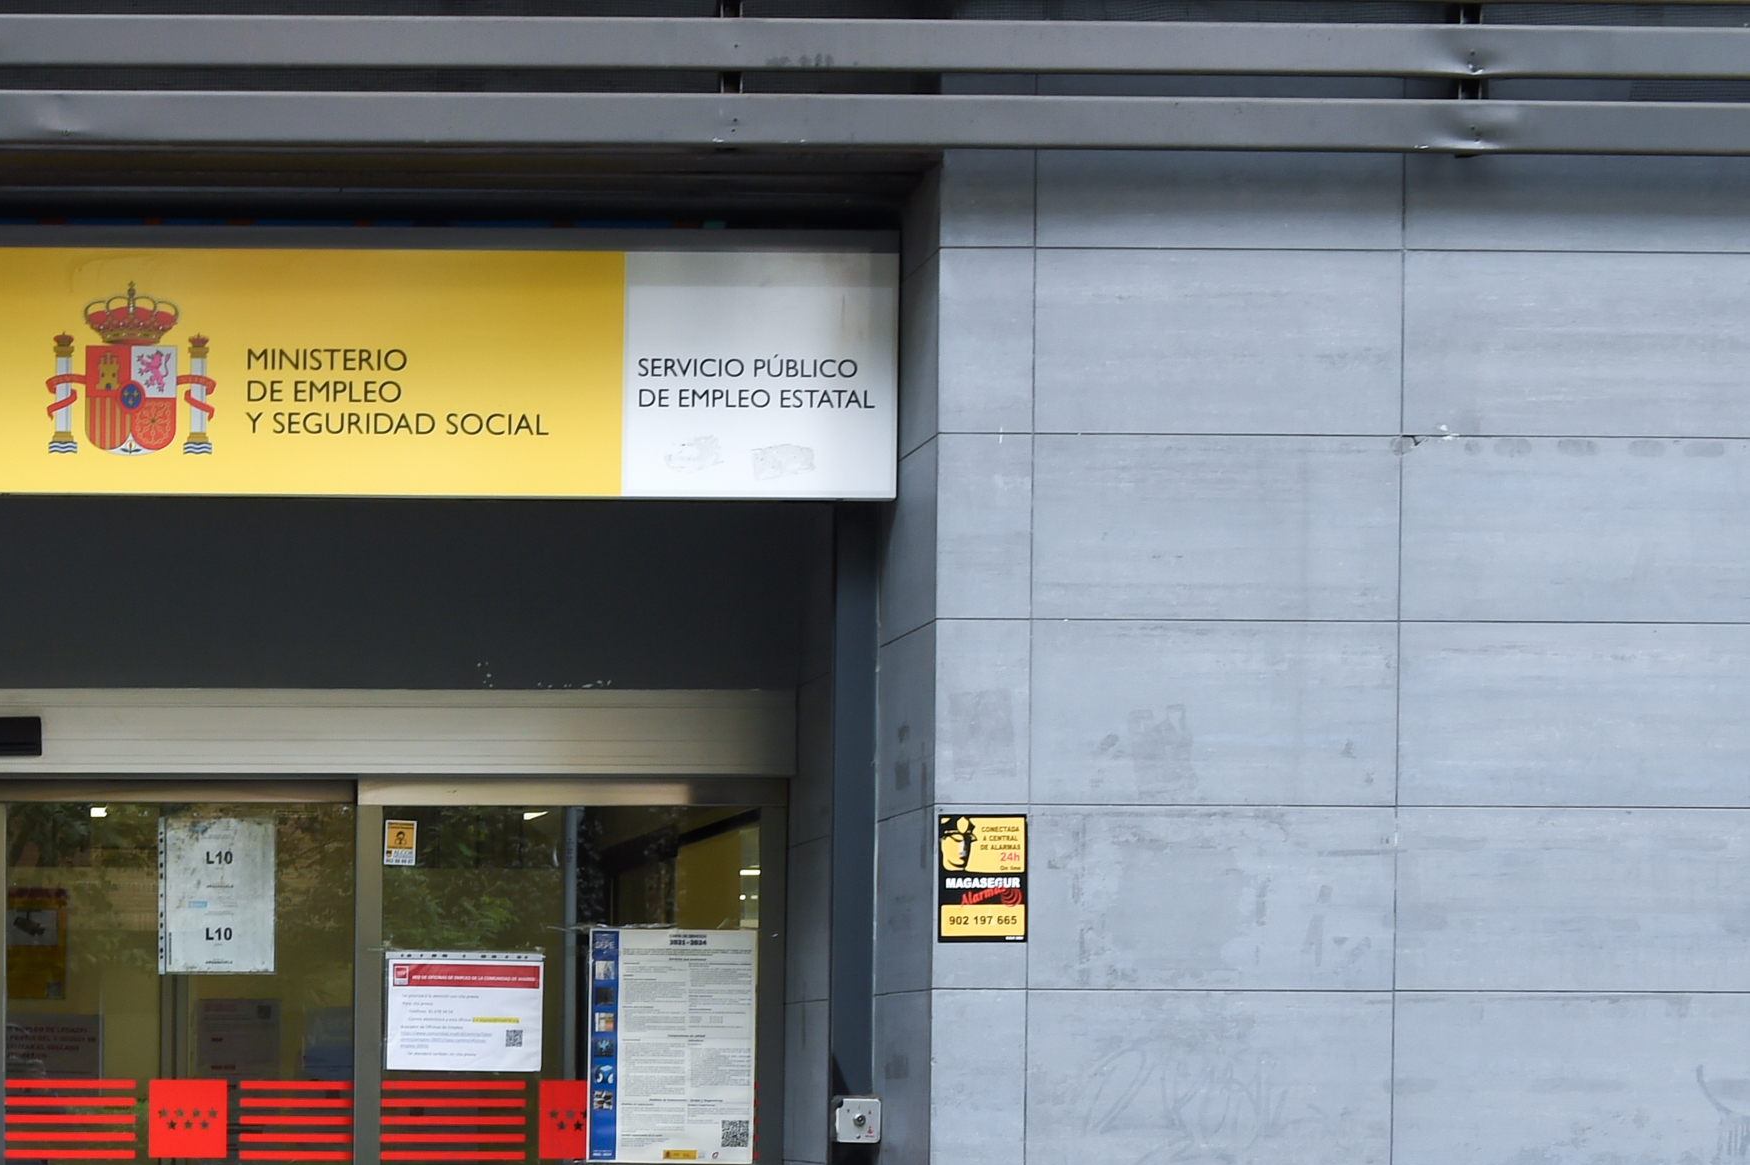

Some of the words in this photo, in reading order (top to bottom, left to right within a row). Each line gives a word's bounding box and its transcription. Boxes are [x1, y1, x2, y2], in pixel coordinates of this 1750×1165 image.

[247, 348, 408, 373] MINISTERIO
[638, 357, 744, 379] SERVICIO
[752, 352, 859, 379] PÚBLICO
[247, 381, 286, 404] DE
[293, 380, 404, 405] EMPLEO
[638, 388, 670, 408] DE
[679, 388, 770, 410] EMPLEO
[780, 389, 876, 410] ESTATAL
[246, 412, 263, 436] Y
[272, 411, 437, 437] SEGURIDAD
[446, 413, 550, 437] SOCIAL
[206, 850, 233, 865] L10
[1000, 852, 1020, 862] 24h
[945, 877, 1020, 889] MAGASEGUR
[949, 916, 969, 925] 902
[974, 916, 993, 925] 197
[997, 916, 1018, 925] 665
[205, 927, 232, 941] L10
